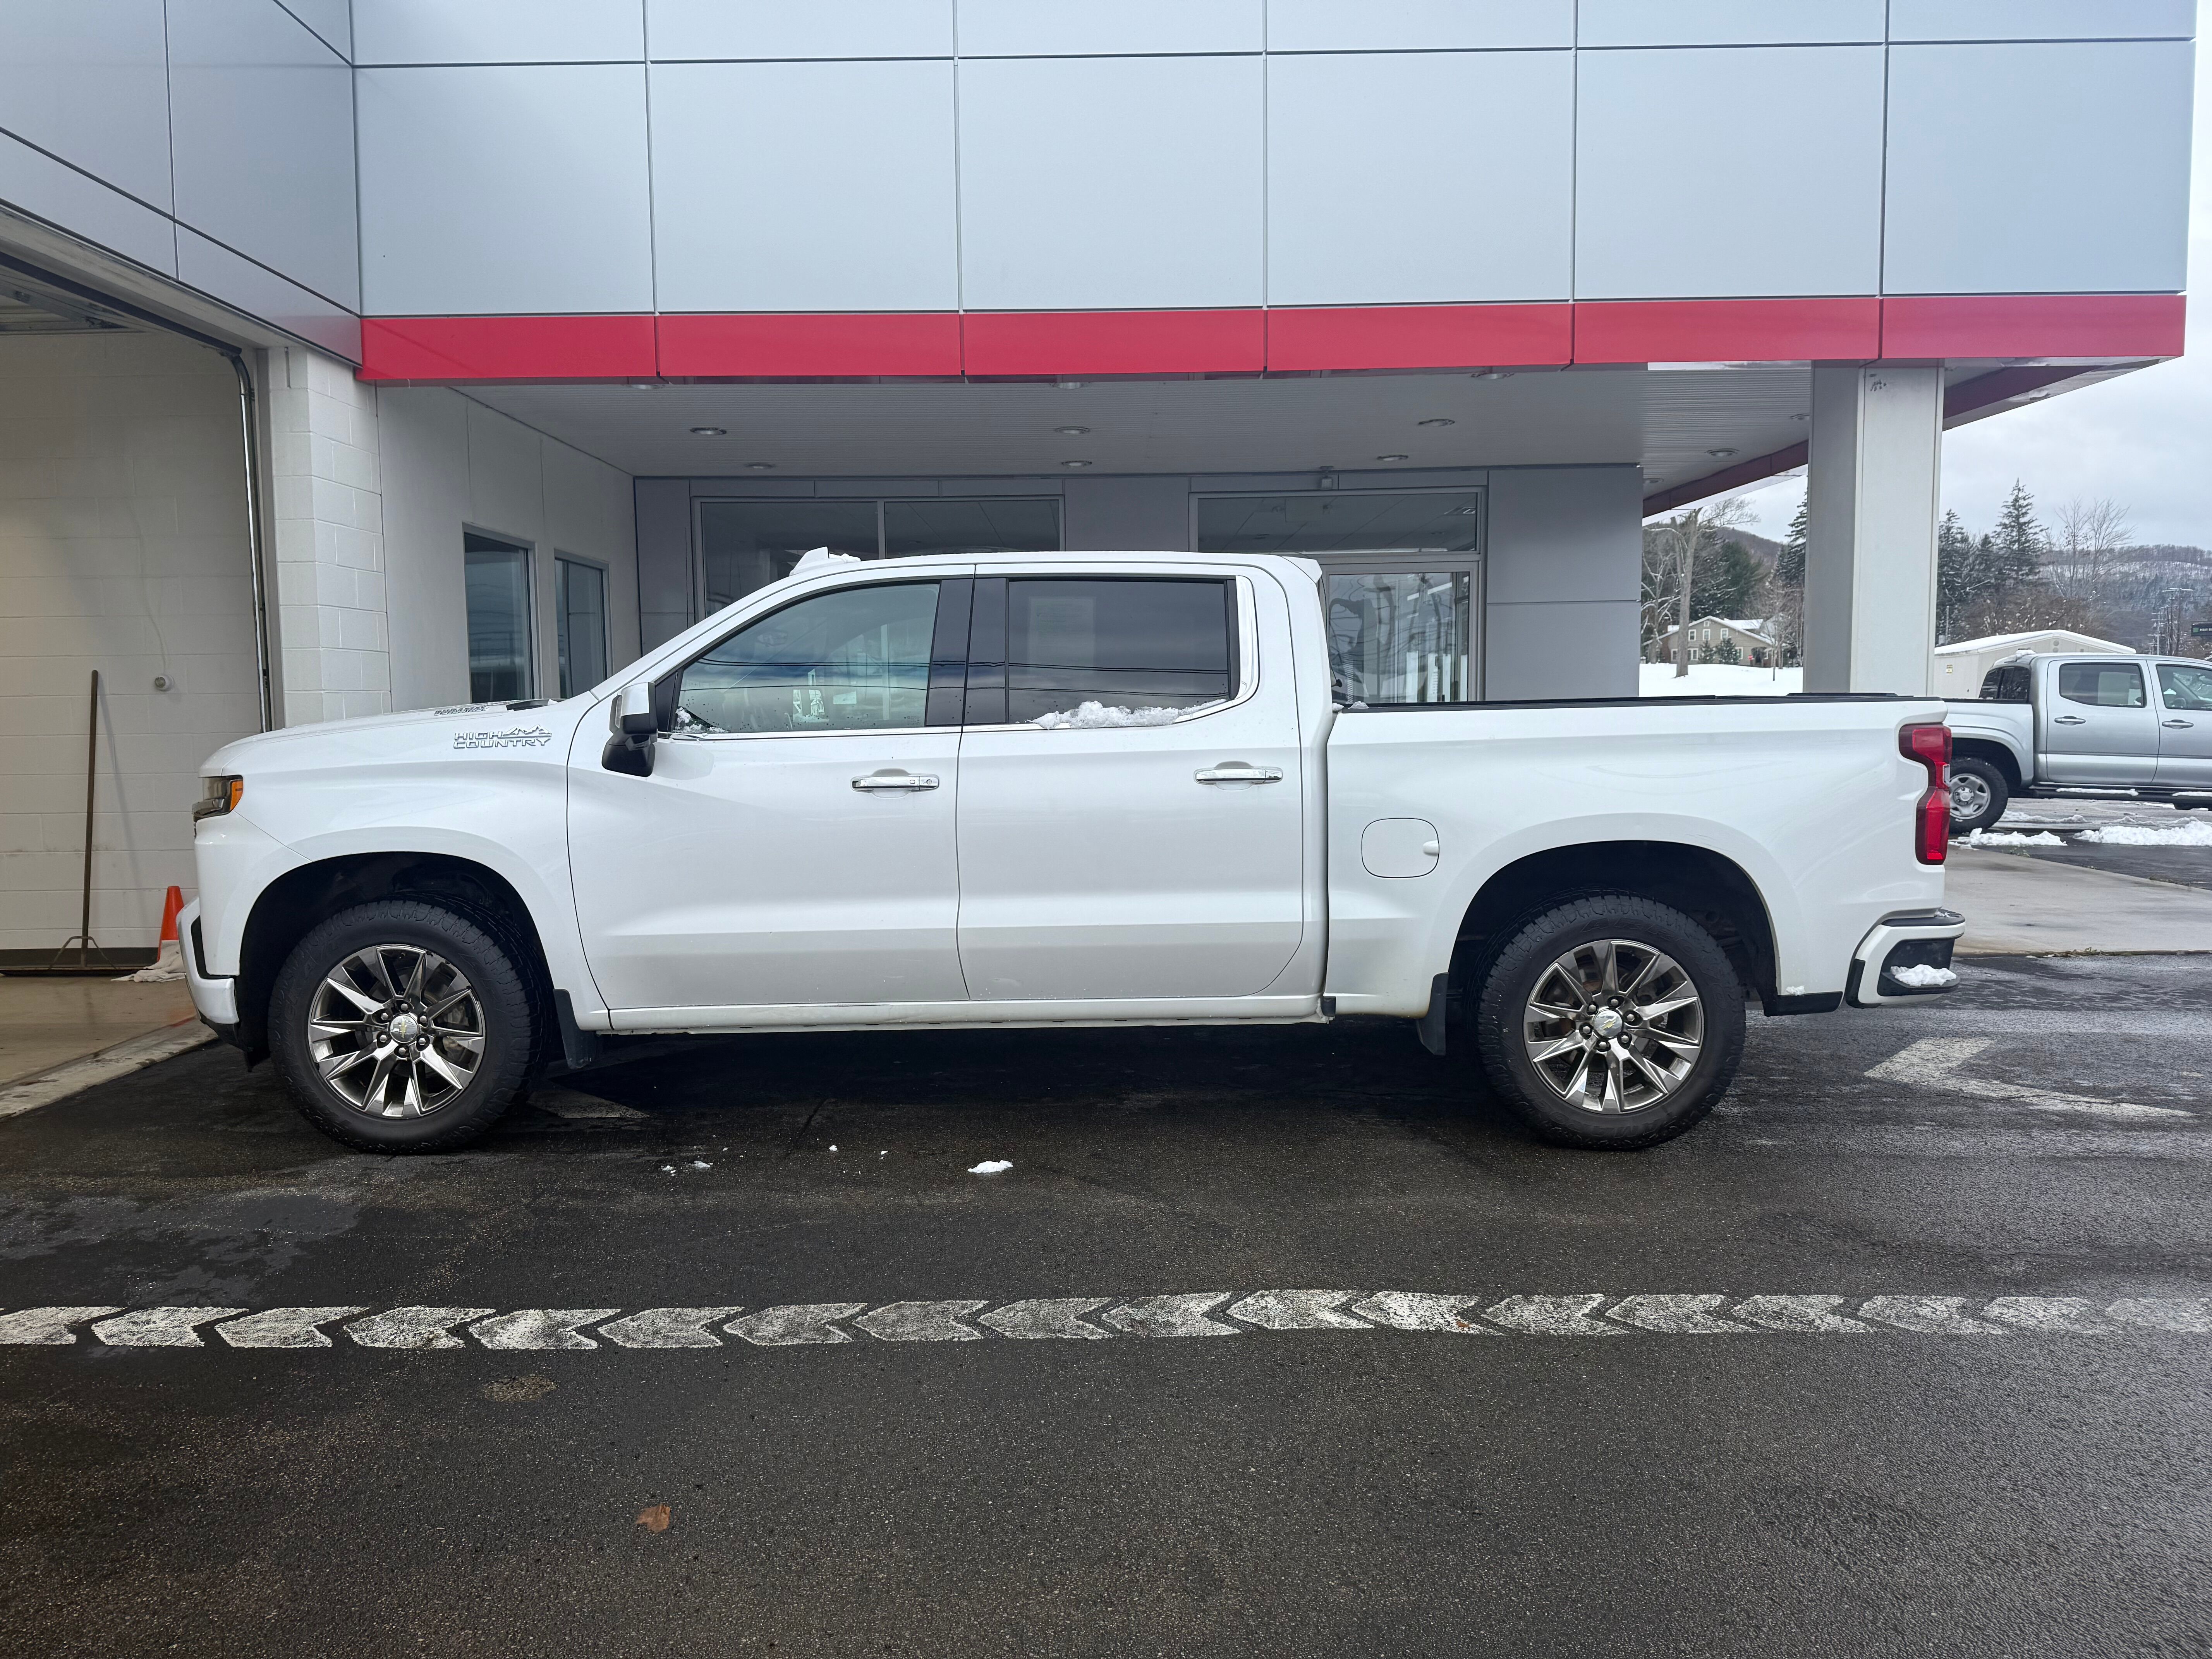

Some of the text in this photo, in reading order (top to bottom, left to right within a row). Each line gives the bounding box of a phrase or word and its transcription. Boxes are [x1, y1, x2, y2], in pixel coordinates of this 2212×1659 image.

[434, 705, 489, 716] DURAMAX
[454, 731, 503, 740] HIGH
[453, 737, 551, 749] COUNTRY
